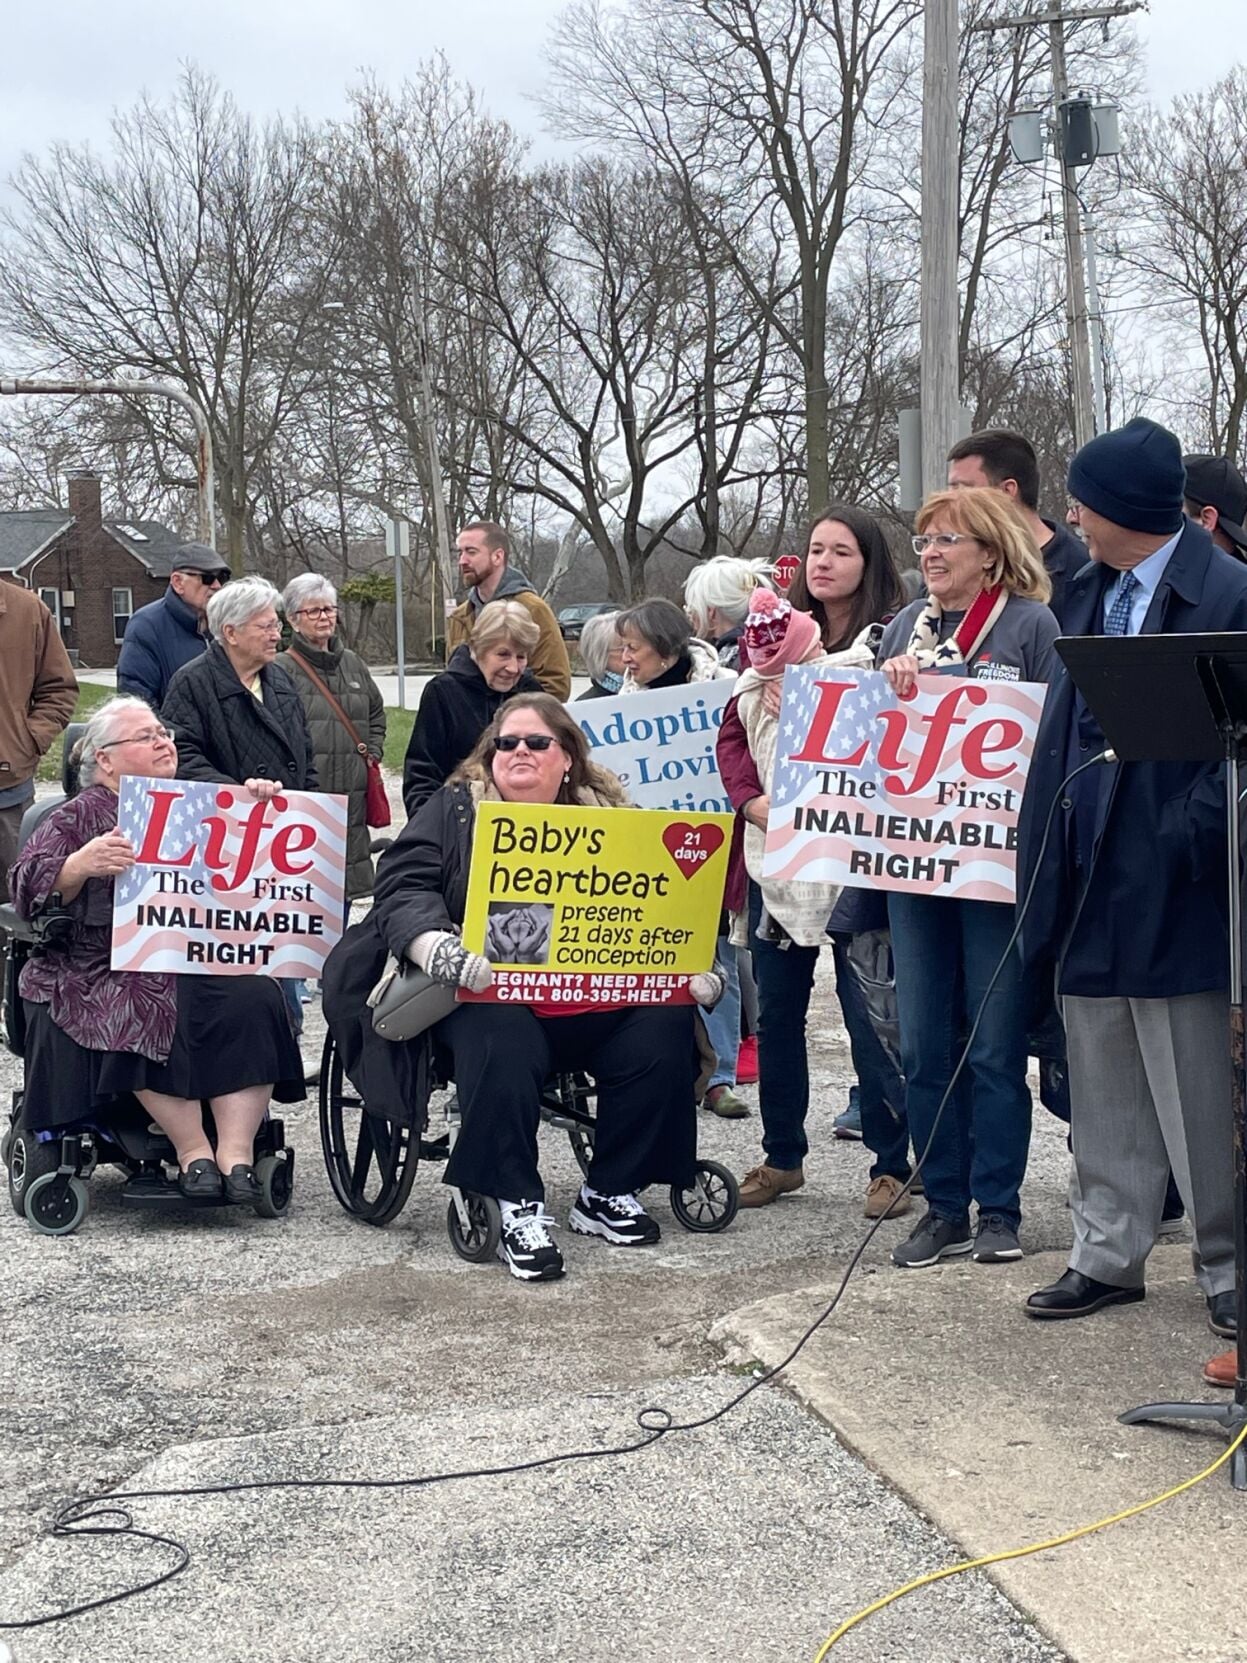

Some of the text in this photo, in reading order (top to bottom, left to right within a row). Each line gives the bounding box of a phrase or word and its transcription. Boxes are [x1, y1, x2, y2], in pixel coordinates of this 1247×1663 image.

[774, 565, 795, 580] STO
[788, 680, 1023, 796] Life
[635, 745, 719, 785] Lovi
[815, 769, 1016, 812] The First
[135, 789, 317, 891] Life
[490, 816, 606, 856] Baby's
[683, 832, 701, 846] 21
[674, 846, 708, 863] days
[849, 849, 960, 883] RIGHT
[152, 870, 314, 902] The First
[488, 860, 670, 900] heartbeat
[136, 904, 324, 936] INALIENABLE
[560, 905, 644, 924] present
[557, 923, 694, 947] 21 days after
[186, 940, 275, 966] RIGHT
[556, 946, 677, 968] conception
[491, 972, 585, 988] REGNANT?
[590, 974, 638, 988] NEED
[497, 986, 672, 1003] CALL 800-395-HELP
